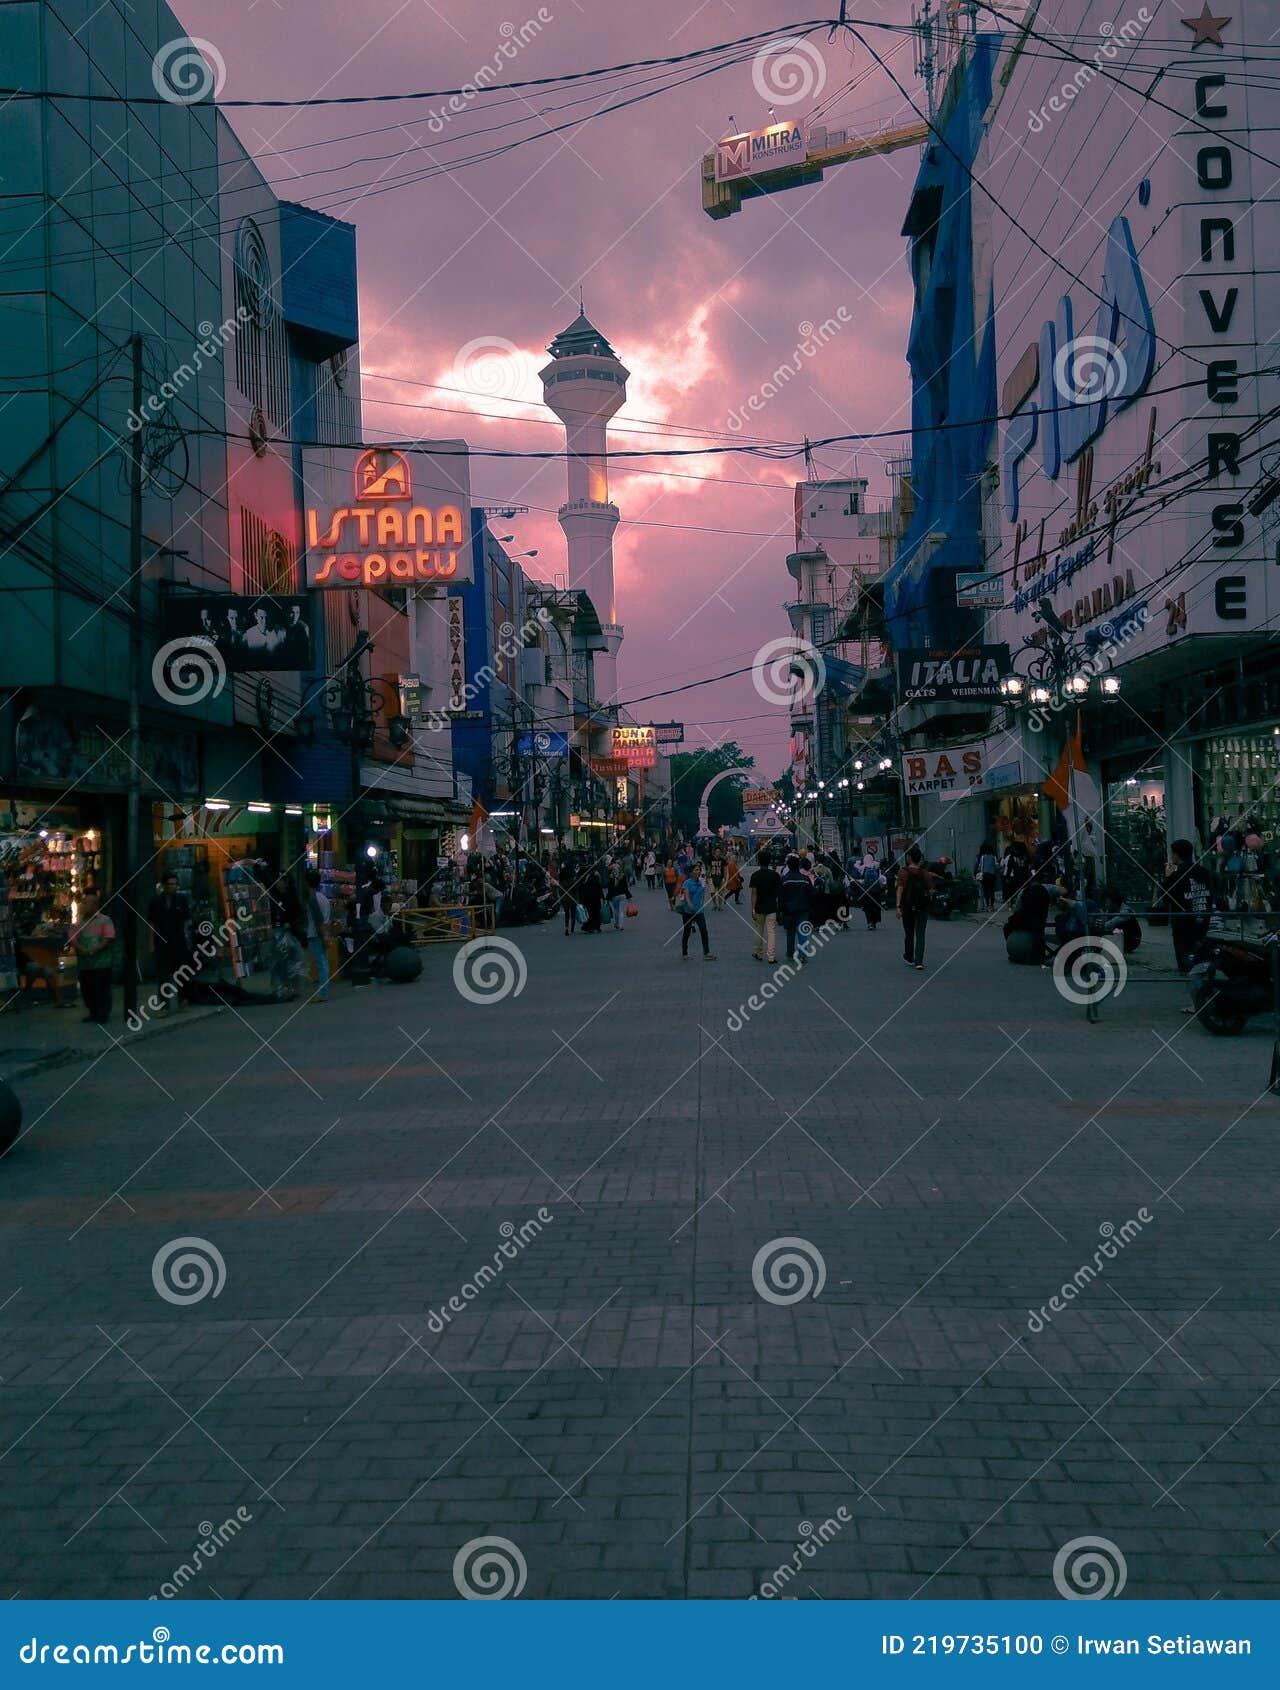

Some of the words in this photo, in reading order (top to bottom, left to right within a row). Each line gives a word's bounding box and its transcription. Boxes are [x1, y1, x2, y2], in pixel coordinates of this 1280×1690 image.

[752, 127, 802, 152] MITRA
[752, 141, 803, 161] KONSTRUKSI
[1195, 74, 1247, 619] CONVERSE
[308, 505, 463, 548] ISTANA
[315, 549, 457, 587] sepatu
[1074, 568, 1137, 627] CANADA
[911, 658, 999, 686] ITALIA
[906, 751, 982, 781] BAS
[909, 778, 956, 793] KARPET
